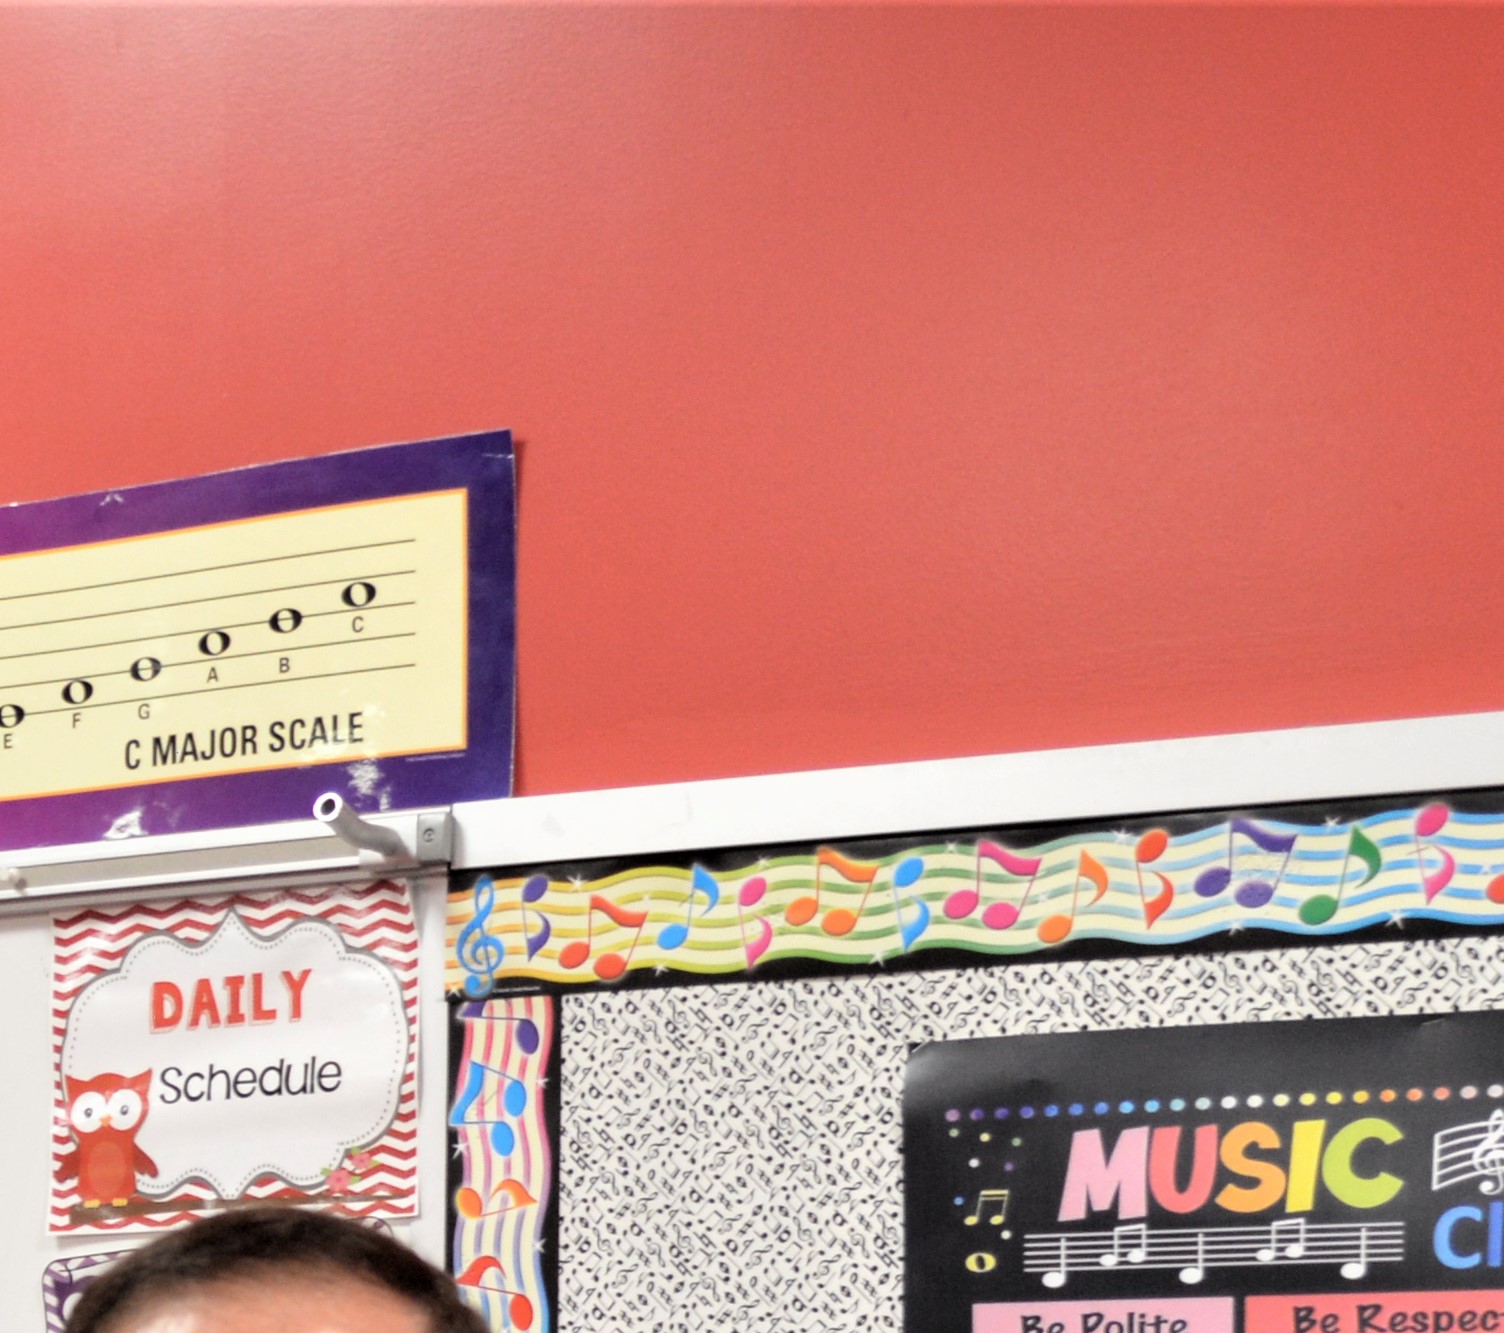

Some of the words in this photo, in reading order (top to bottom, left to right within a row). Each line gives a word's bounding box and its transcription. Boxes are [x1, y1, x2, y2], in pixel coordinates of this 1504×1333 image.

[351, 615, 365, 633] C
[278, 657, 290, 674] B
[206, 666, 220, 684] A
[72, 712, 81, 729] F
[137, 703, 151, 721] G
[3, 733, 13, 750] E
[124, 738, 142, 770] C
[151, 724, 259, 767] MAJOR
[268, 711, 364, 753] SCALE
[150, 967, 313, 1035] DAILY
[159, 1055, 342, 1105] Schedule
[1056, 1117, 1405, 1224] MUSIC
